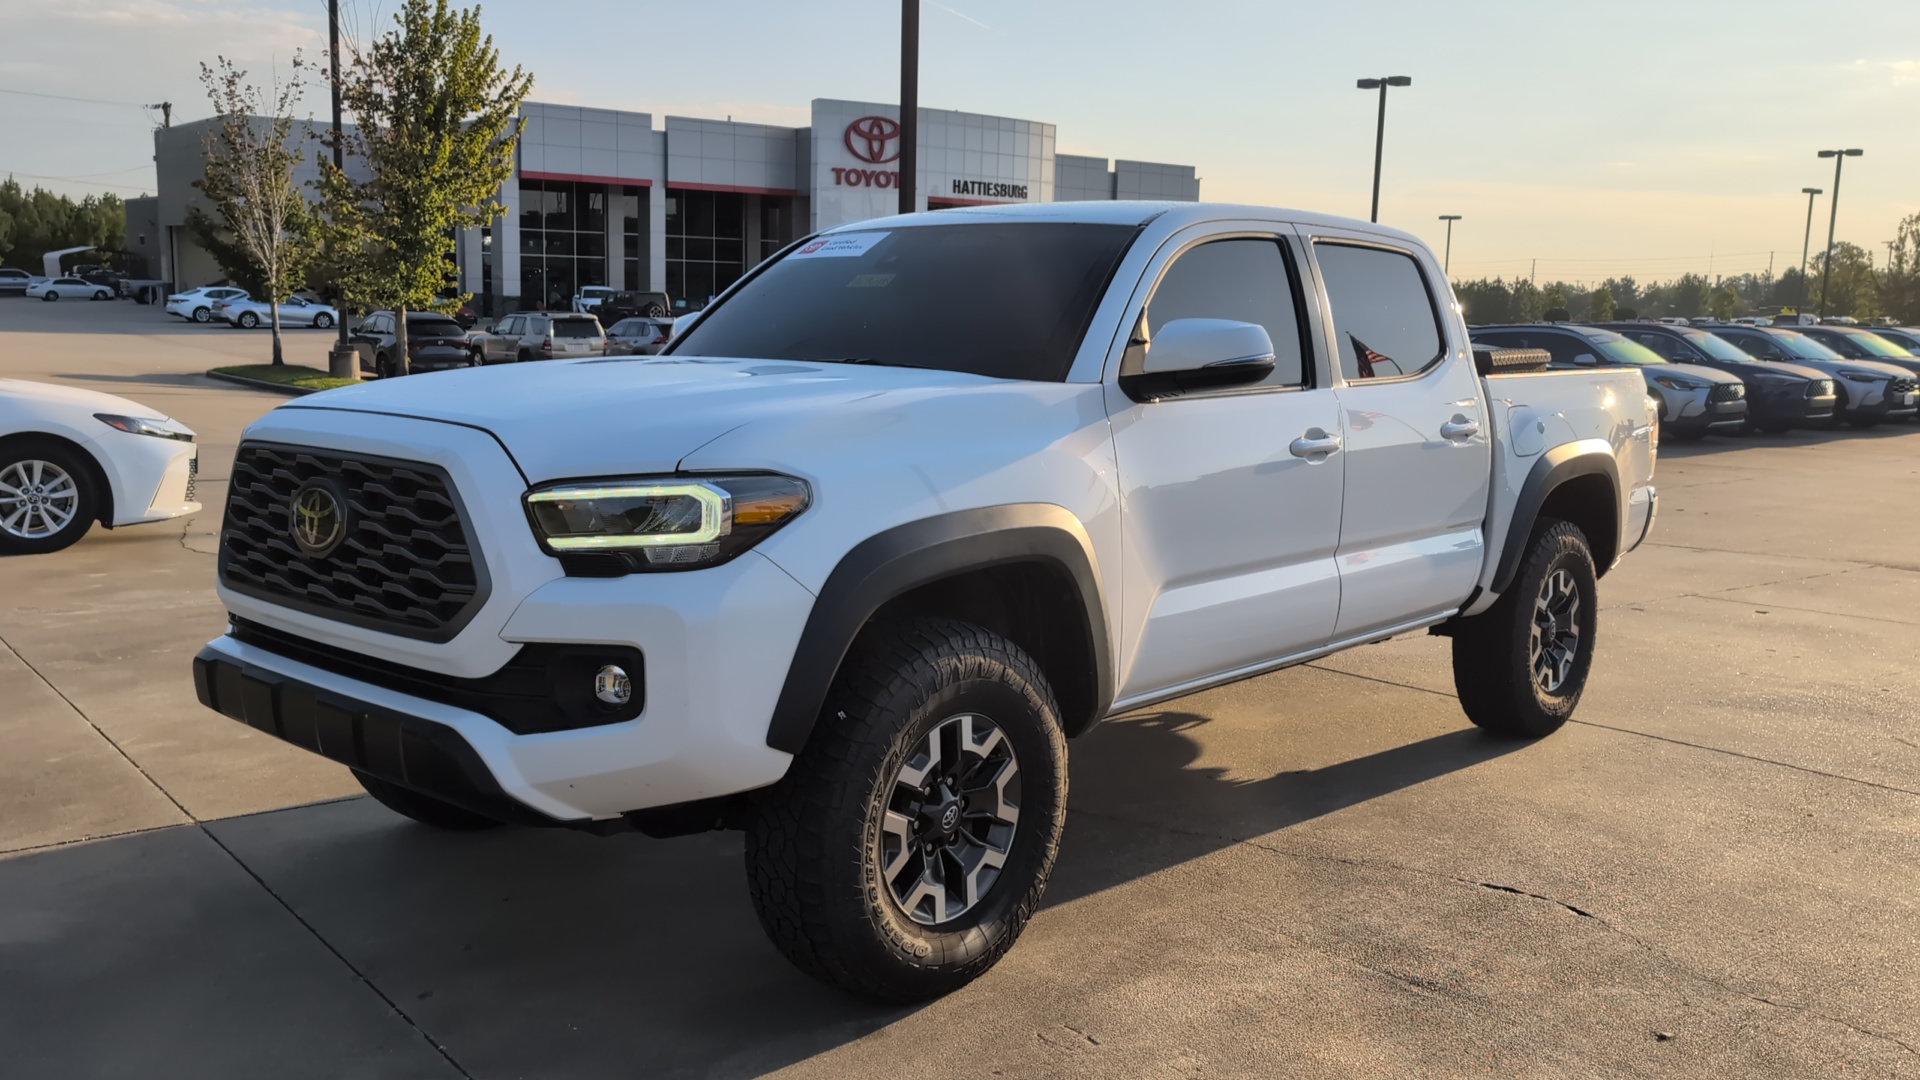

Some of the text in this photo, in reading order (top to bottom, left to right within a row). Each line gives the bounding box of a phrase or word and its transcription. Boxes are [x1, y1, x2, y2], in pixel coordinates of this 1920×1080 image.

[831, 167, 900, 189] TOYOT
[952, 179, 1028, 199] HATTIESBURG
[881, 917, 929, 958] OPEN
